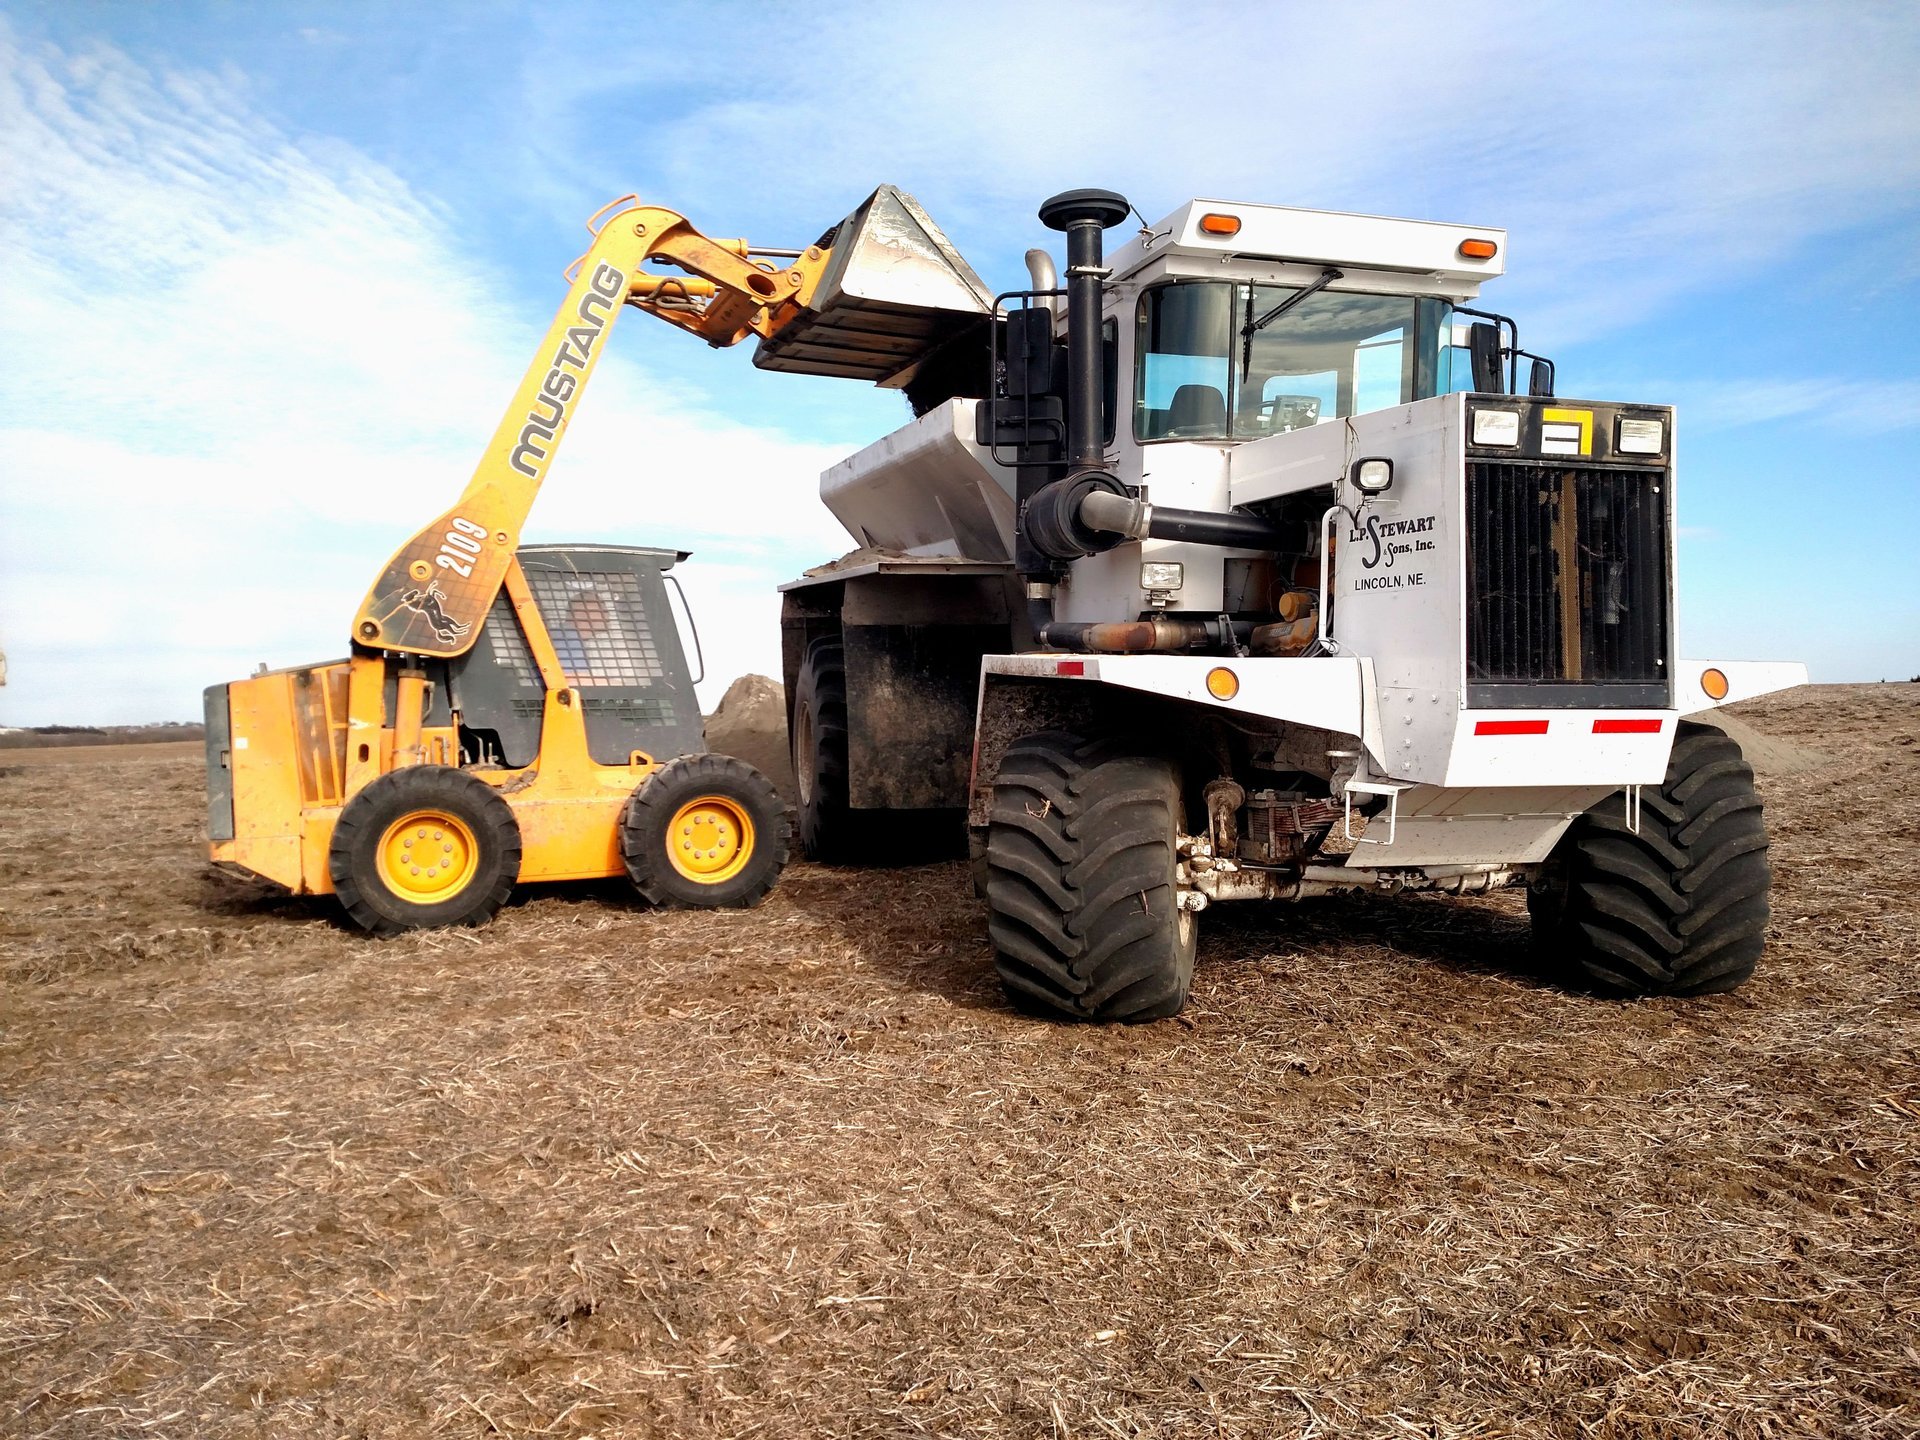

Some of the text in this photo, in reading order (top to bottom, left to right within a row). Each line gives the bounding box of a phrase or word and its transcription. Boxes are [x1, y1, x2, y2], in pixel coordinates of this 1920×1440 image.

[510, 263, 624, 478] MUSTANG
[435, 517, 488, 578] 2109
[1349, 515, 1436, 569] L.P. STEWART
[1415, 540, 1436, 552] Inc.
[1354, 572, 1426, 591] LINCOLN, NE.
